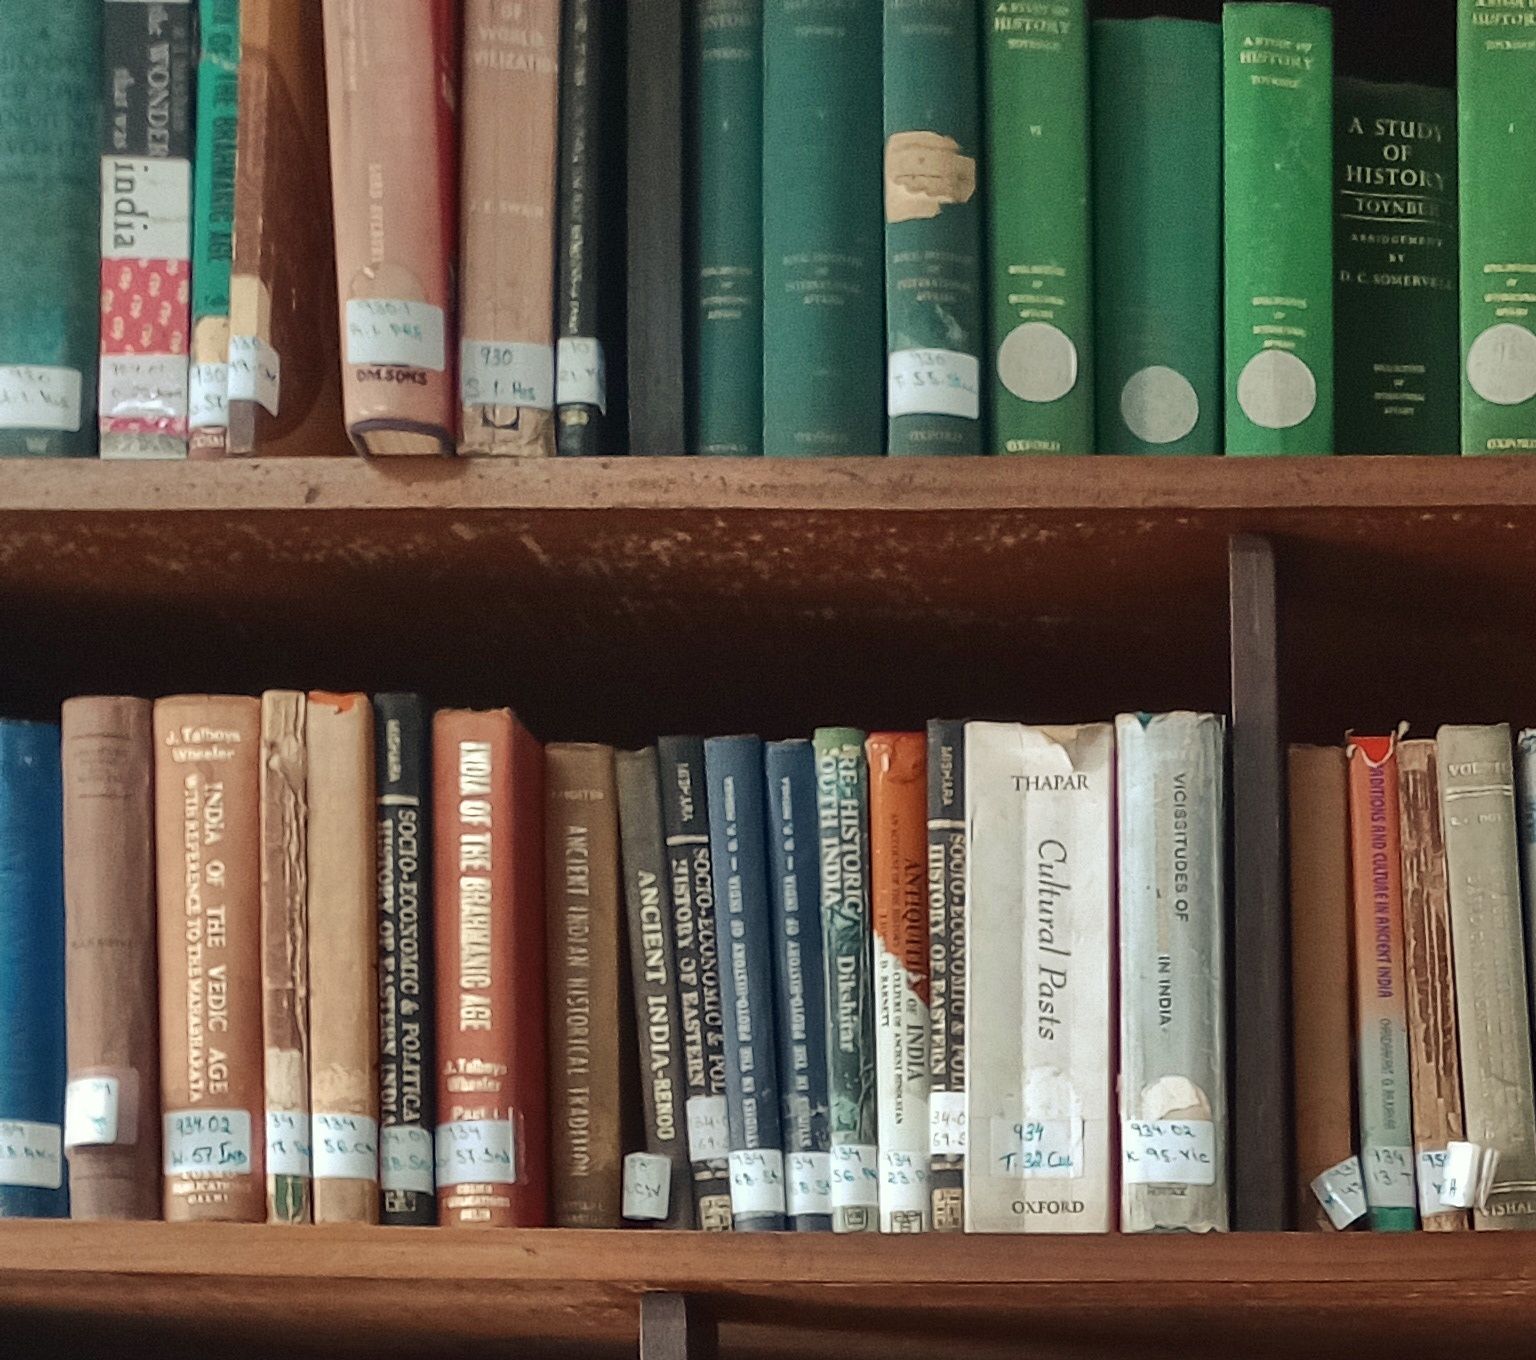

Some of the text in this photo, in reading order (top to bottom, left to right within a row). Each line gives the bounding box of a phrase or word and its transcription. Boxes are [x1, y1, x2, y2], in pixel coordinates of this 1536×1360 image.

[1350, 117, 1441, 142] A STUDY
[1383, 144, 1411, 162] OF
[1347, 165, 1444, 190] HISTORY
[114, 162, 149, 249] india
[459, 741, 491, 797] INDIA
[1011, 774, 1089, 792] THAPAR
[459, 800, 491, 827] OF
[459, 832, 492, 872] THE
[1173, 772, 1189, 923] VICISSITUDES OF
[205, 782, 230, 1095] INDIA OF THE VEDIC AGE
[637, 868, 667, 987] ANCIENT
[1037, 838, 1072, 1042] Cultural Pasts
[1157, 953, 1173, 1028] IN INDIA
[459, 995, 492, 1031] AGE
[1011, 1198, 1085, 1216] OXFORD
